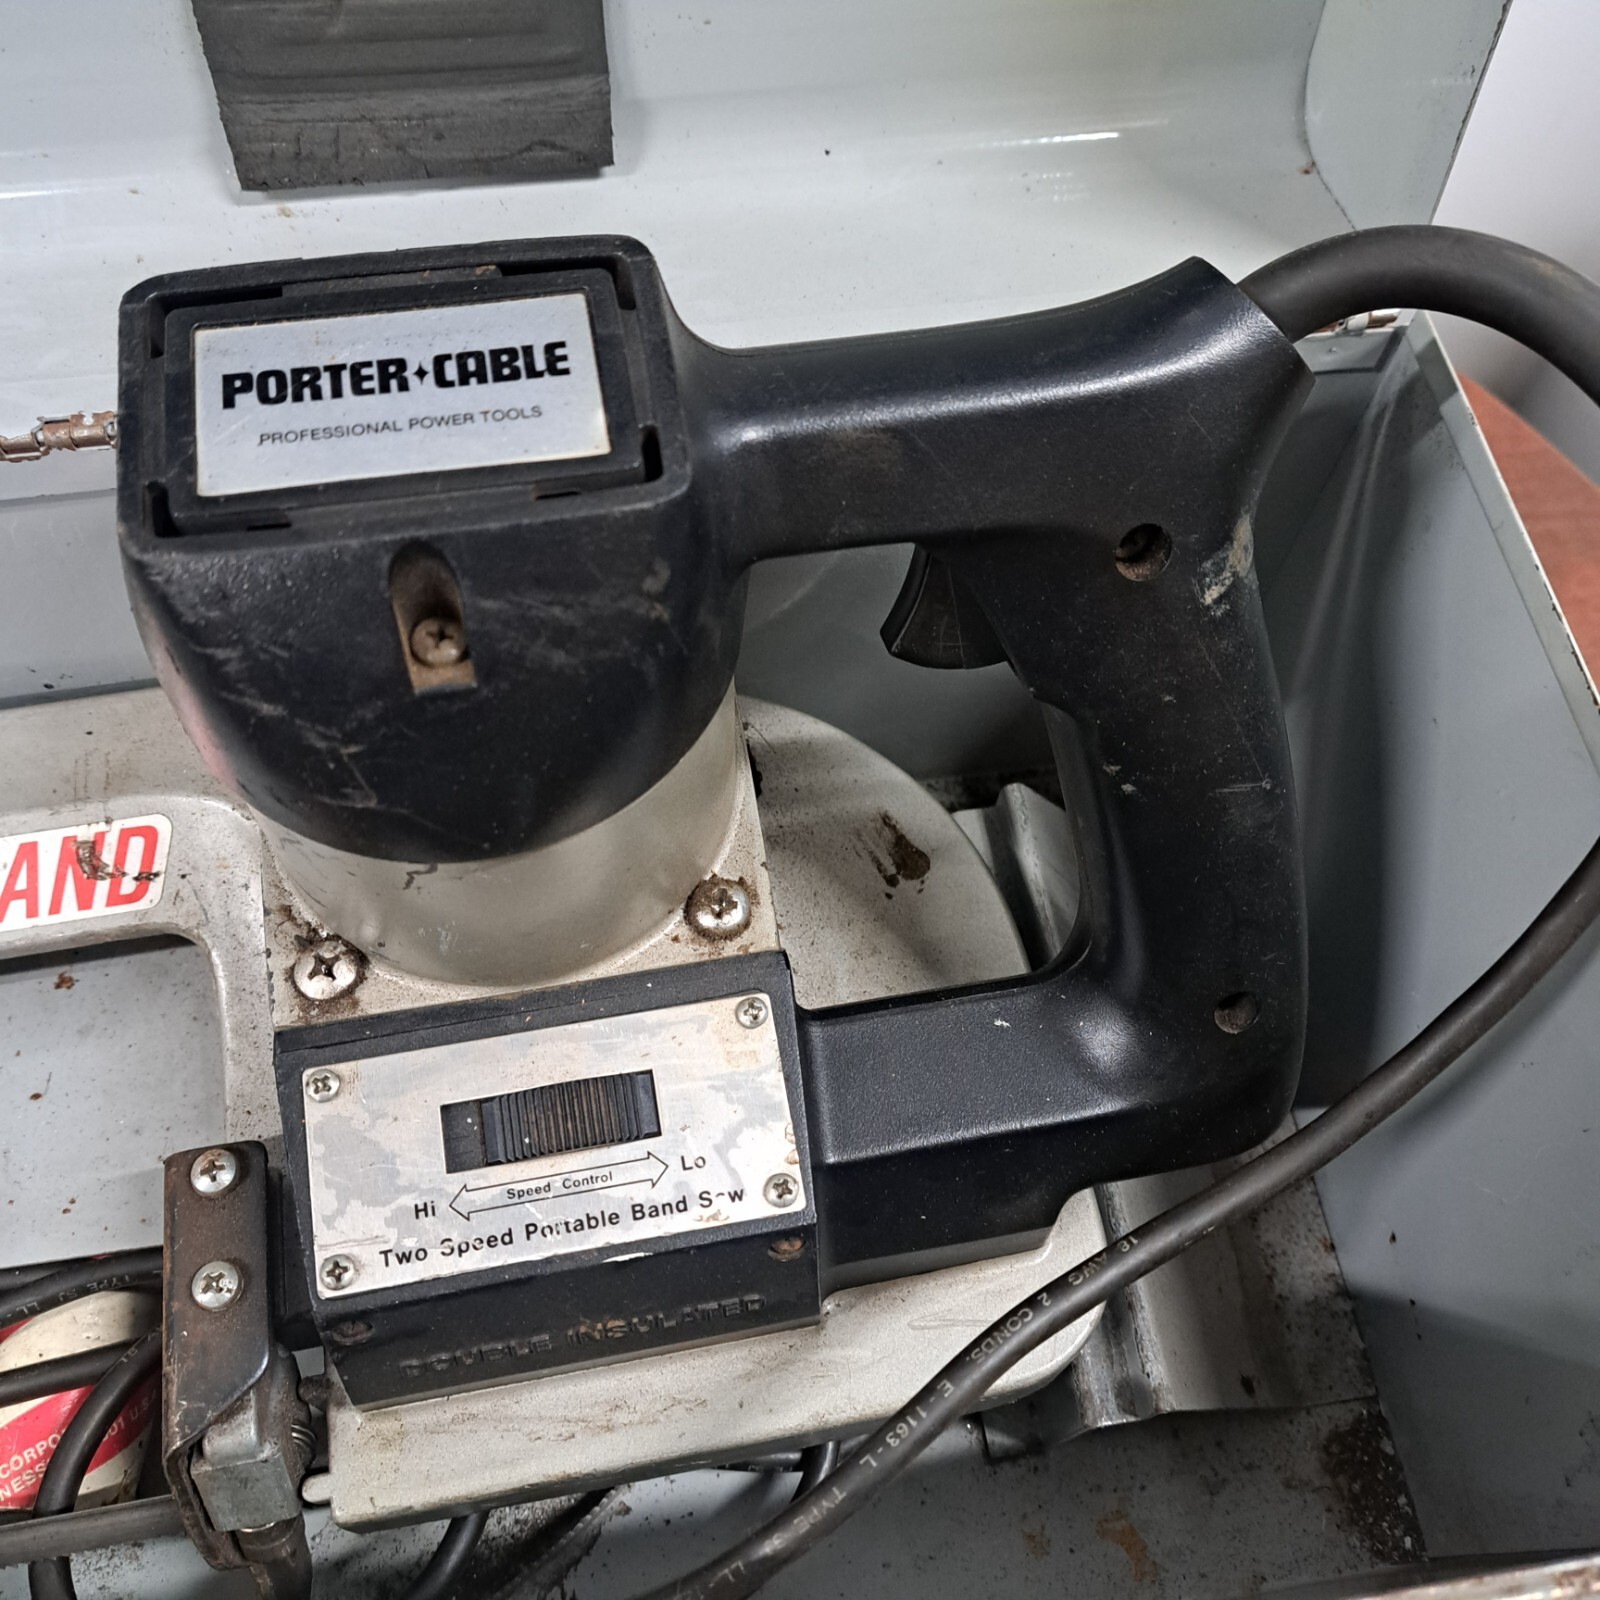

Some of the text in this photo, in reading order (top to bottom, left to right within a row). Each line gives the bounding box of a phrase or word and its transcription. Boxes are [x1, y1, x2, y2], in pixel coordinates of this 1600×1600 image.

[222, 341, 571, 410] PORTER CABLE
[258, 404, 543, 446] PROFESSIONAL POWER TOOLS
[681, 1154, 706, 1172] Lo
[506, 1171, 613, 1200] Speed Control
[379, 1188, 744, 1268] Two Speed Portable Band Sw
[414, 1200, 436, 1220] Hi
[1067, 1253, 1108, 1286] AWG
[1037, 1291, 1052, 1307] 2
[401, 1294, 767, 1378] DOUBLE INSULATED
[0, 1427, 67, 1479] CORPO
[793, 1486, 848, 1534] TYPE
